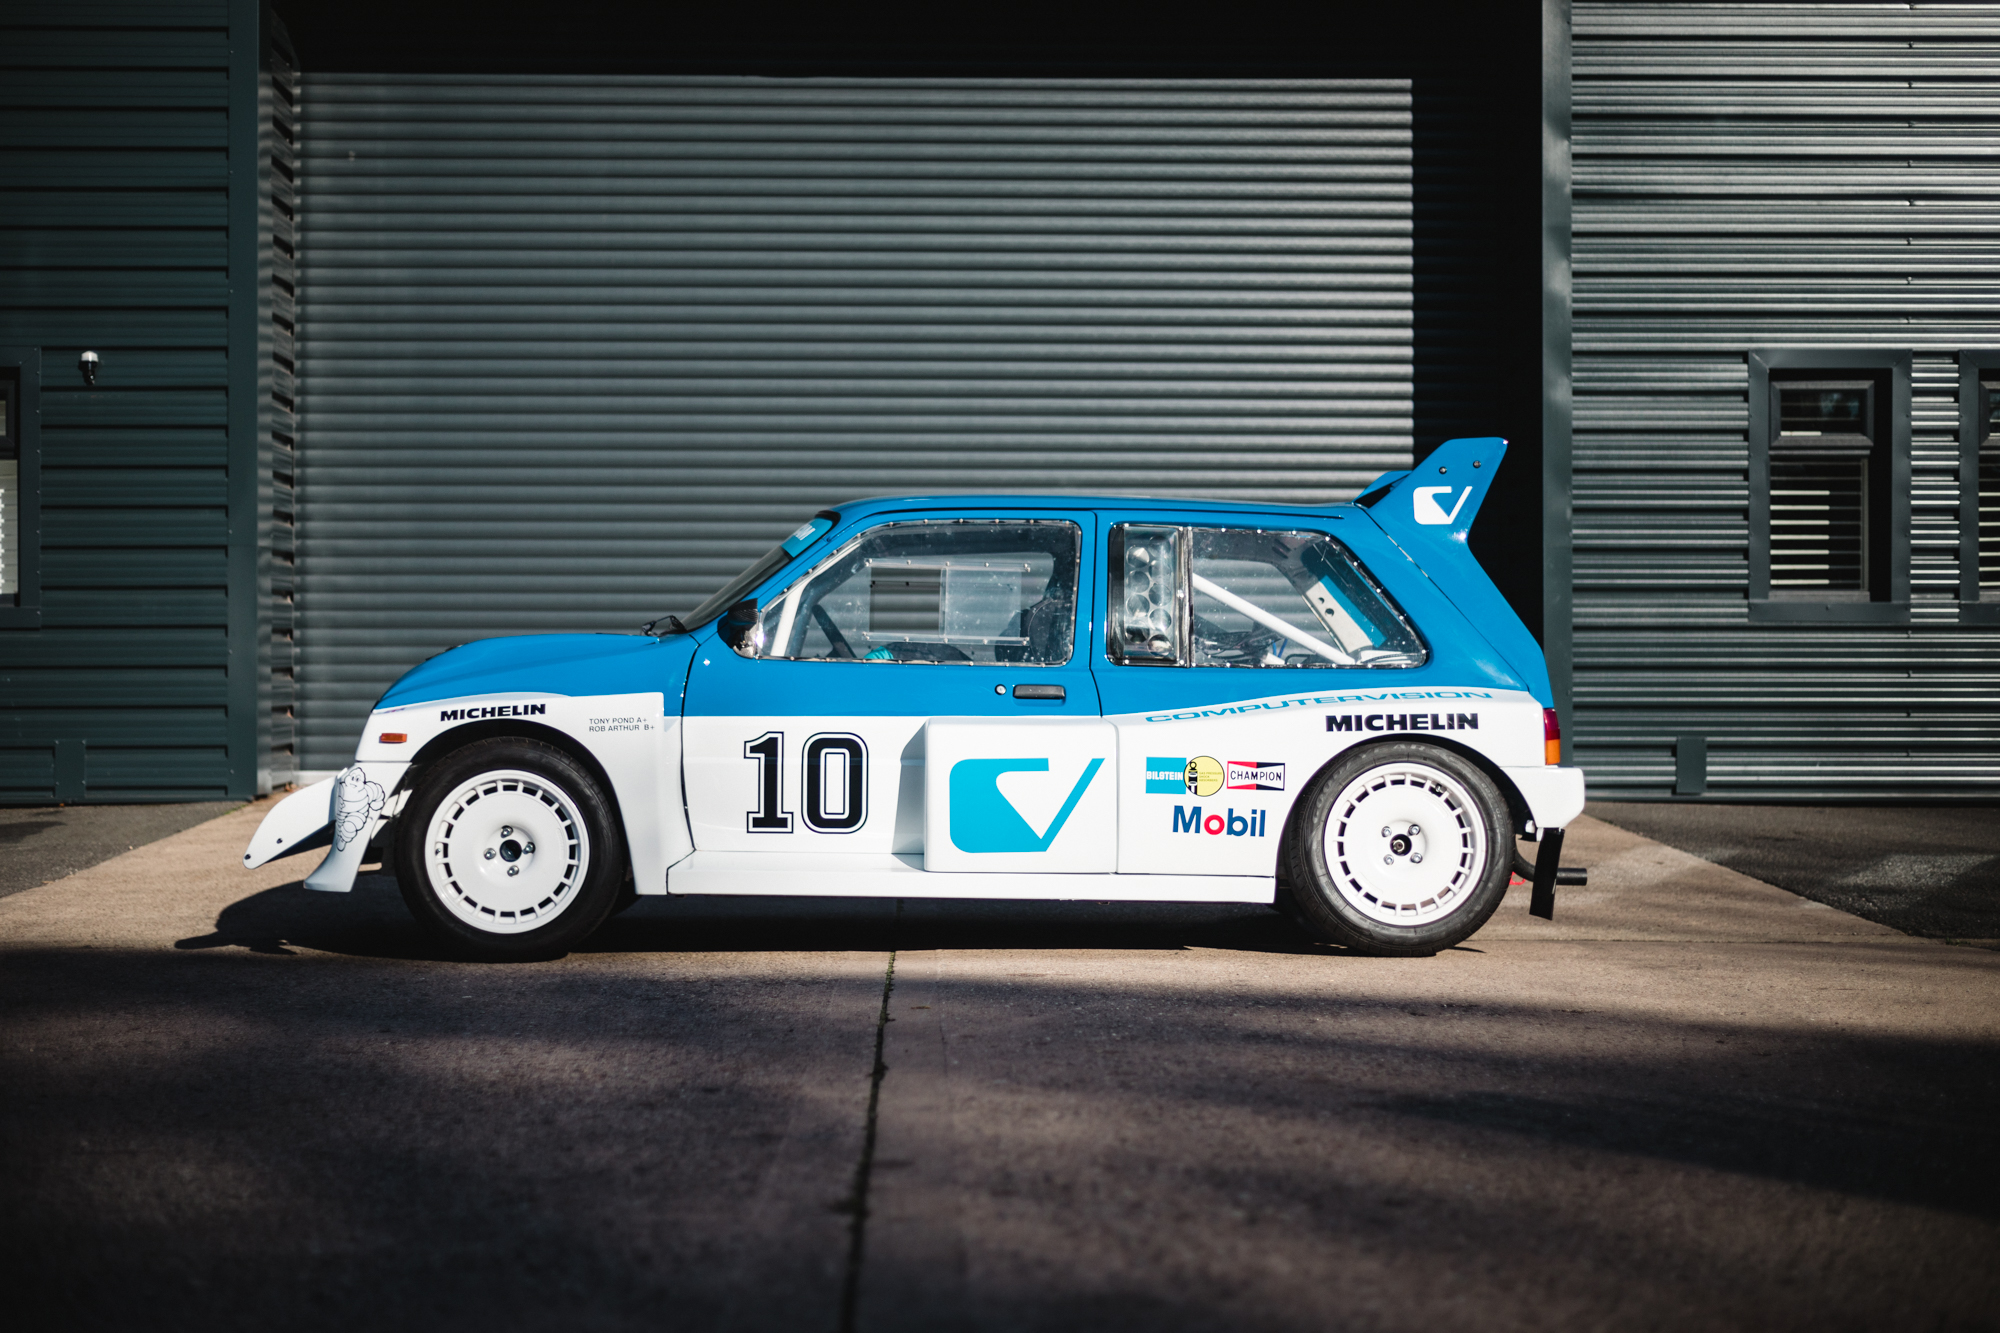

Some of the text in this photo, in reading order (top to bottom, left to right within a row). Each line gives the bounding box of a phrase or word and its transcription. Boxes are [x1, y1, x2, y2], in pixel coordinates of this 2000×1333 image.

[440, 703, 546, 722] MICHELIN
[1145, 690, 1493, 723] COMPUTERVISION
[589, 717, 610, 725] TONY
[1325, 713, 1479, 732] MICHELIN
[743, 731, 869, 835] 10
[1146, 770, 1184, 781] BILSTEIN
[1229, 770, 1282, 782] CHAMPION
[1172, 805, 1266, 837] Mobil
